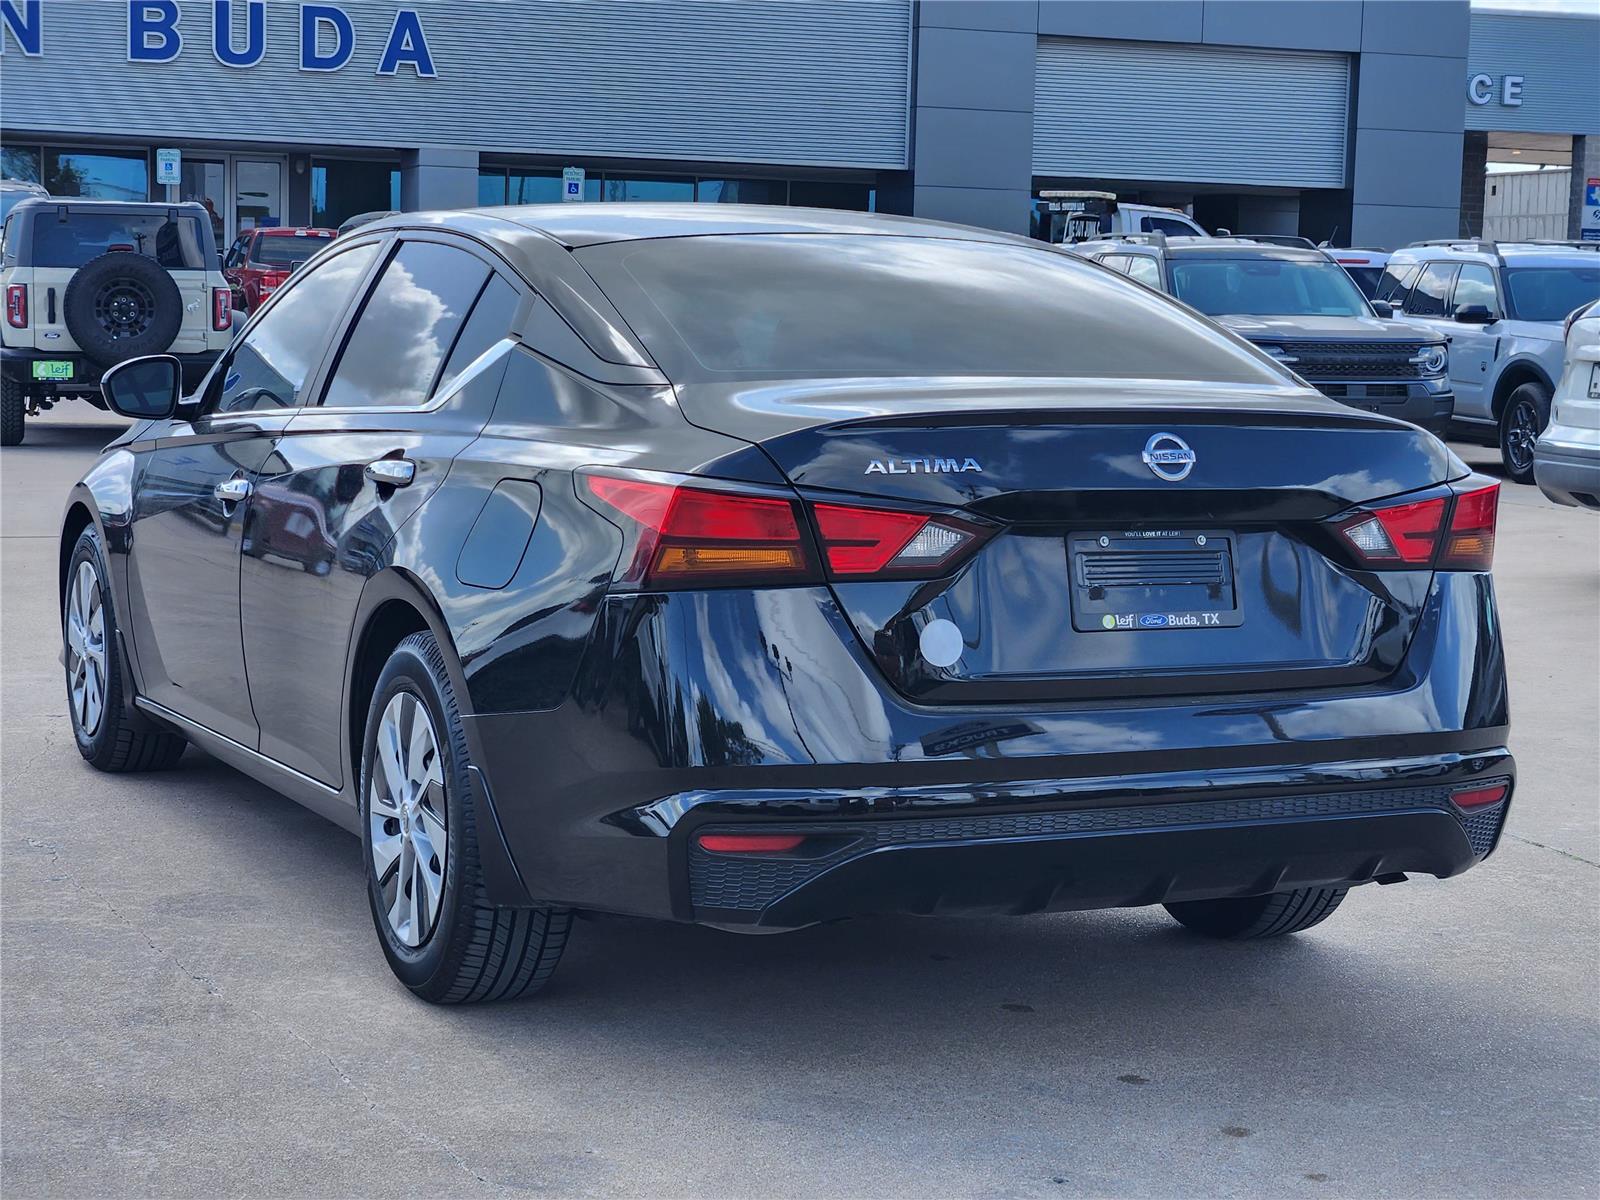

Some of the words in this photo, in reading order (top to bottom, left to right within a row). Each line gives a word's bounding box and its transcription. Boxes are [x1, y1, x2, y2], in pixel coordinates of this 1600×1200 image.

[127, 0, 439, 78] BUDA
[1151, 452, 1191, 461] NISSAN
[864, 457, 983, 475] ALTIMA
[1168, 613, 1200, 626] Buda,
[1202, 612, 1220, 625] TX
